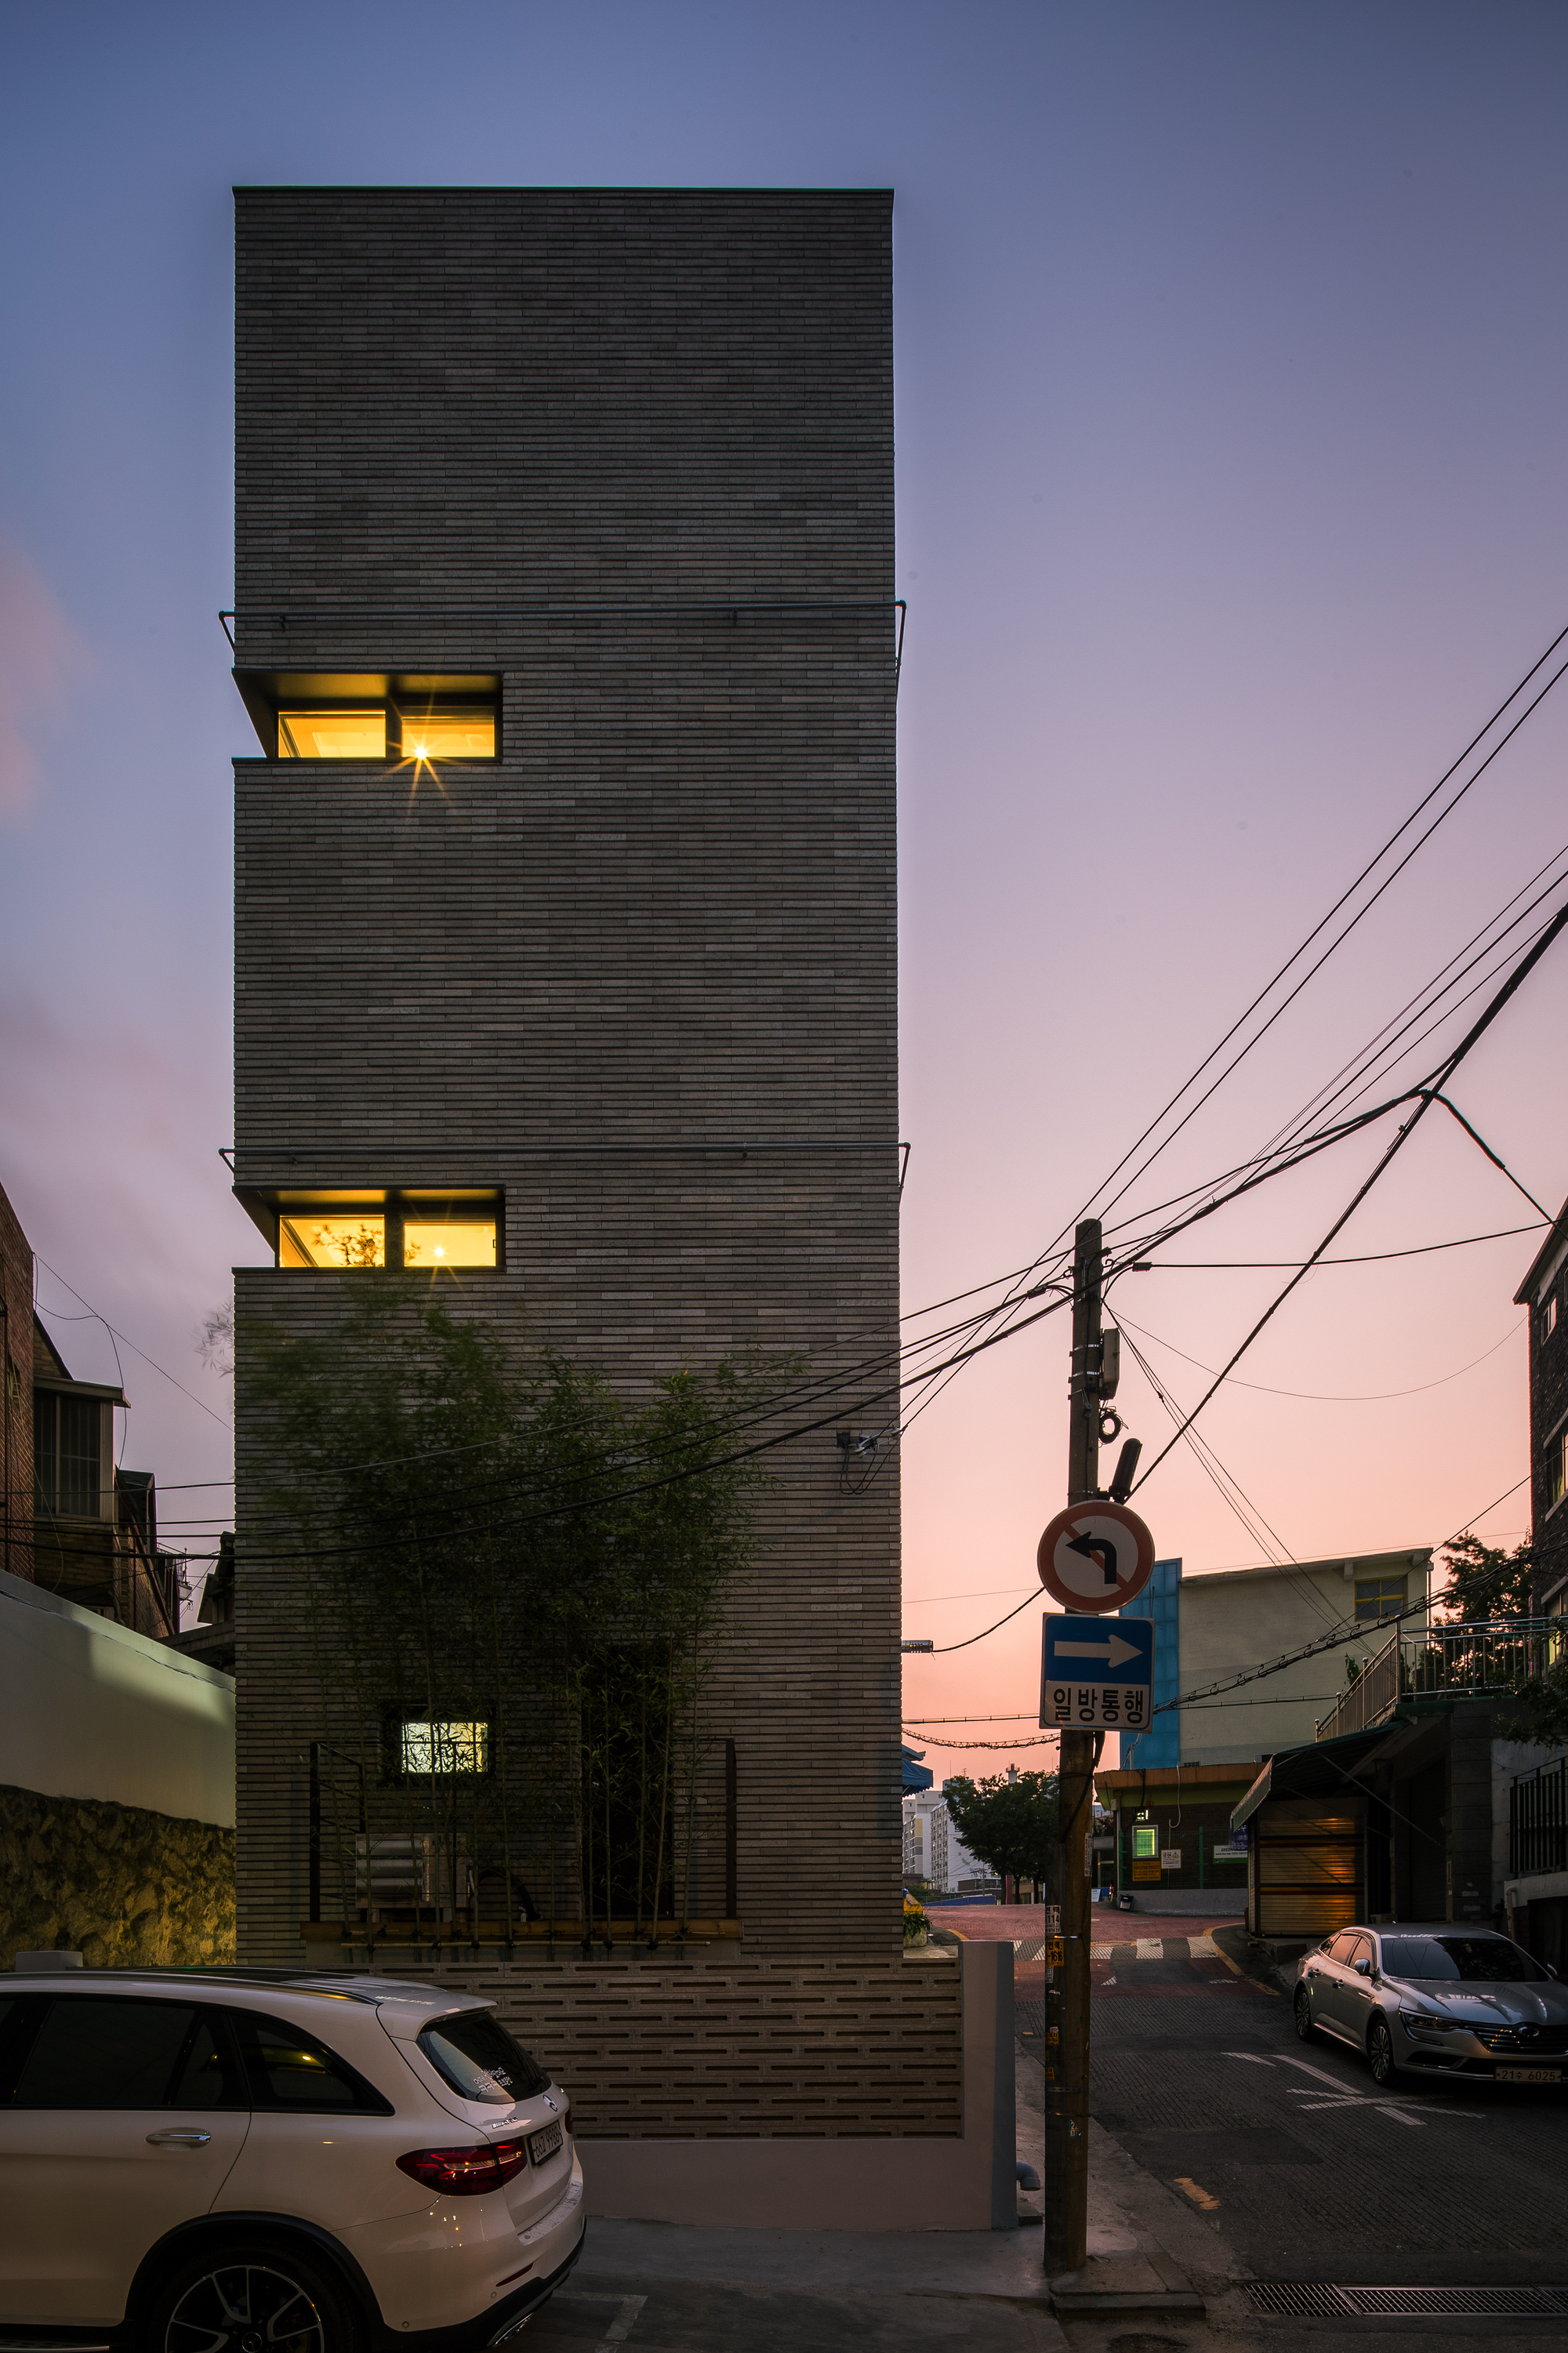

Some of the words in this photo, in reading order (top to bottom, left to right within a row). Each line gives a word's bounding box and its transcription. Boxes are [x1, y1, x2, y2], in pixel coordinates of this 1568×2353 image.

[1053, 1687, 1144, 1724] 일방통행
[1501, 2070, 1523, 2079] 21수
[1528, 2071, 1555, 2081] 6025
